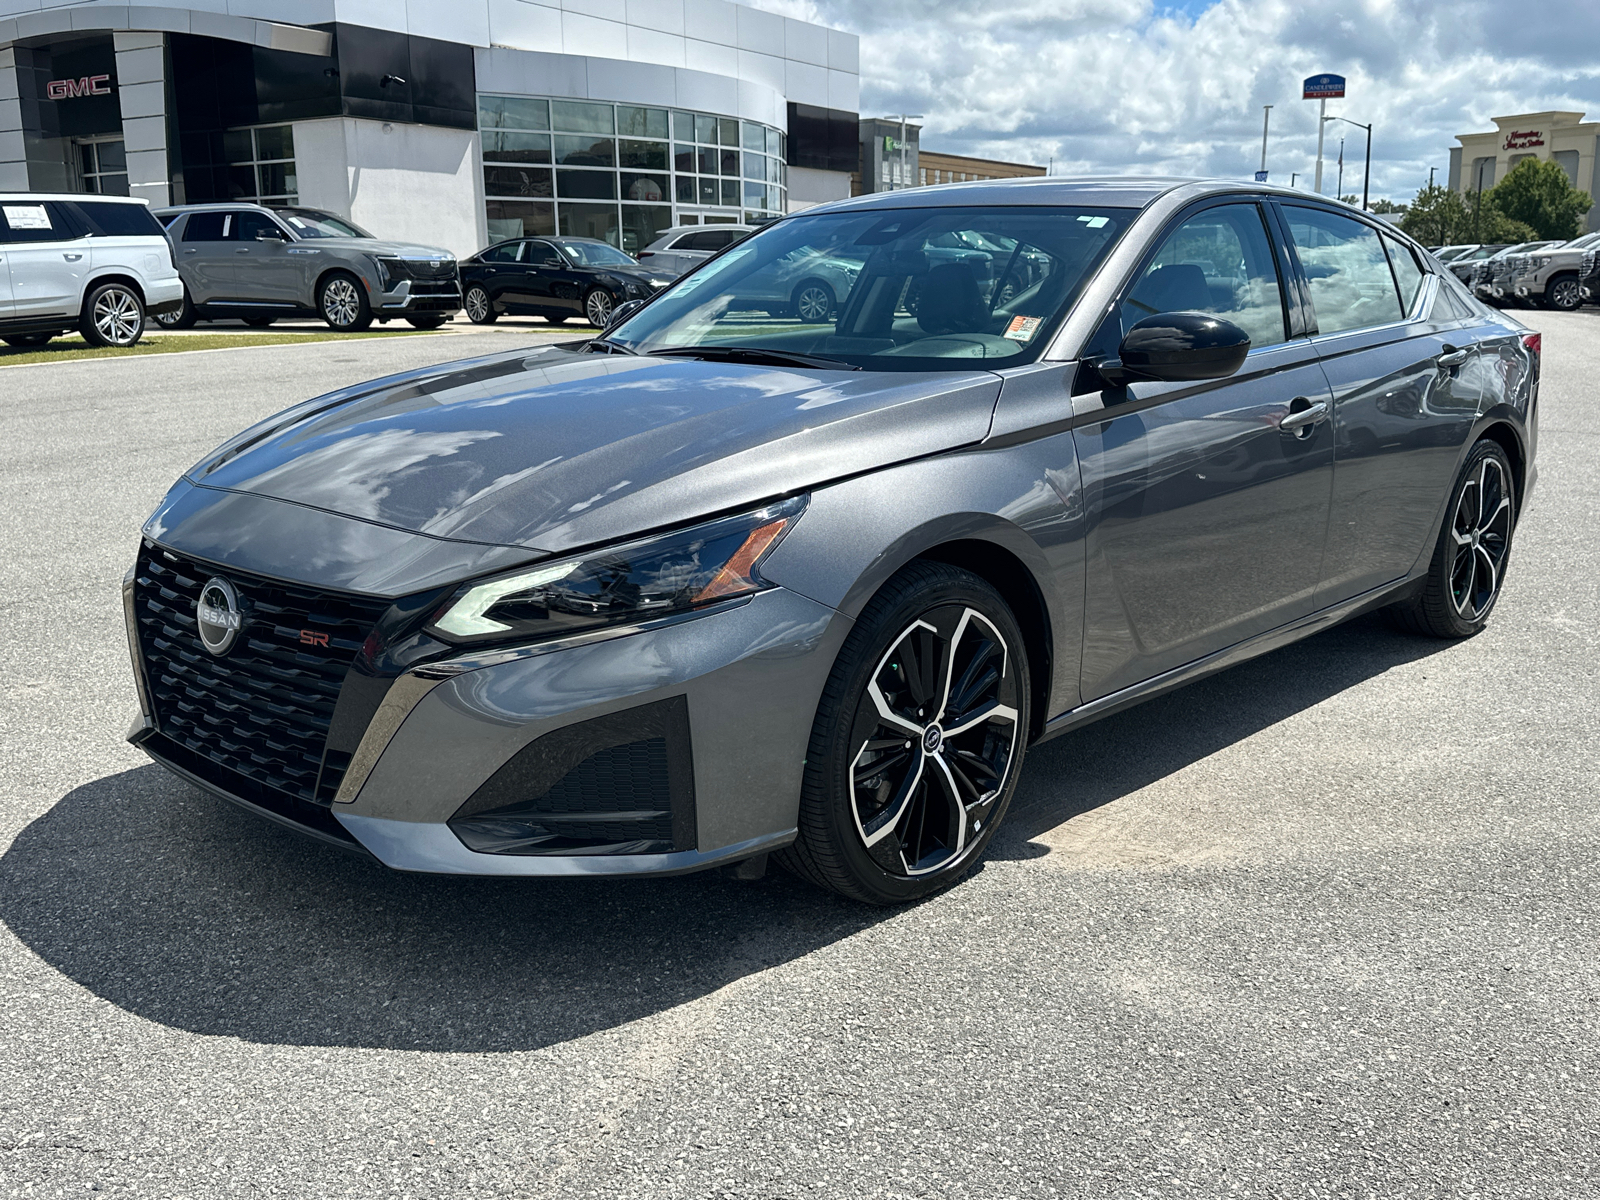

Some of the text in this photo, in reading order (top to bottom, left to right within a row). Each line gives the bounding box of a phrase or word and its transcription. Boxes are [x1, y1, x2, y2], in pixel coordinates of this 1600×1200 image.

[47, 74, 111, 99] GMC
[1506, 130, 1542, 141] Hampton
[300, 629, 329, 648] SR
